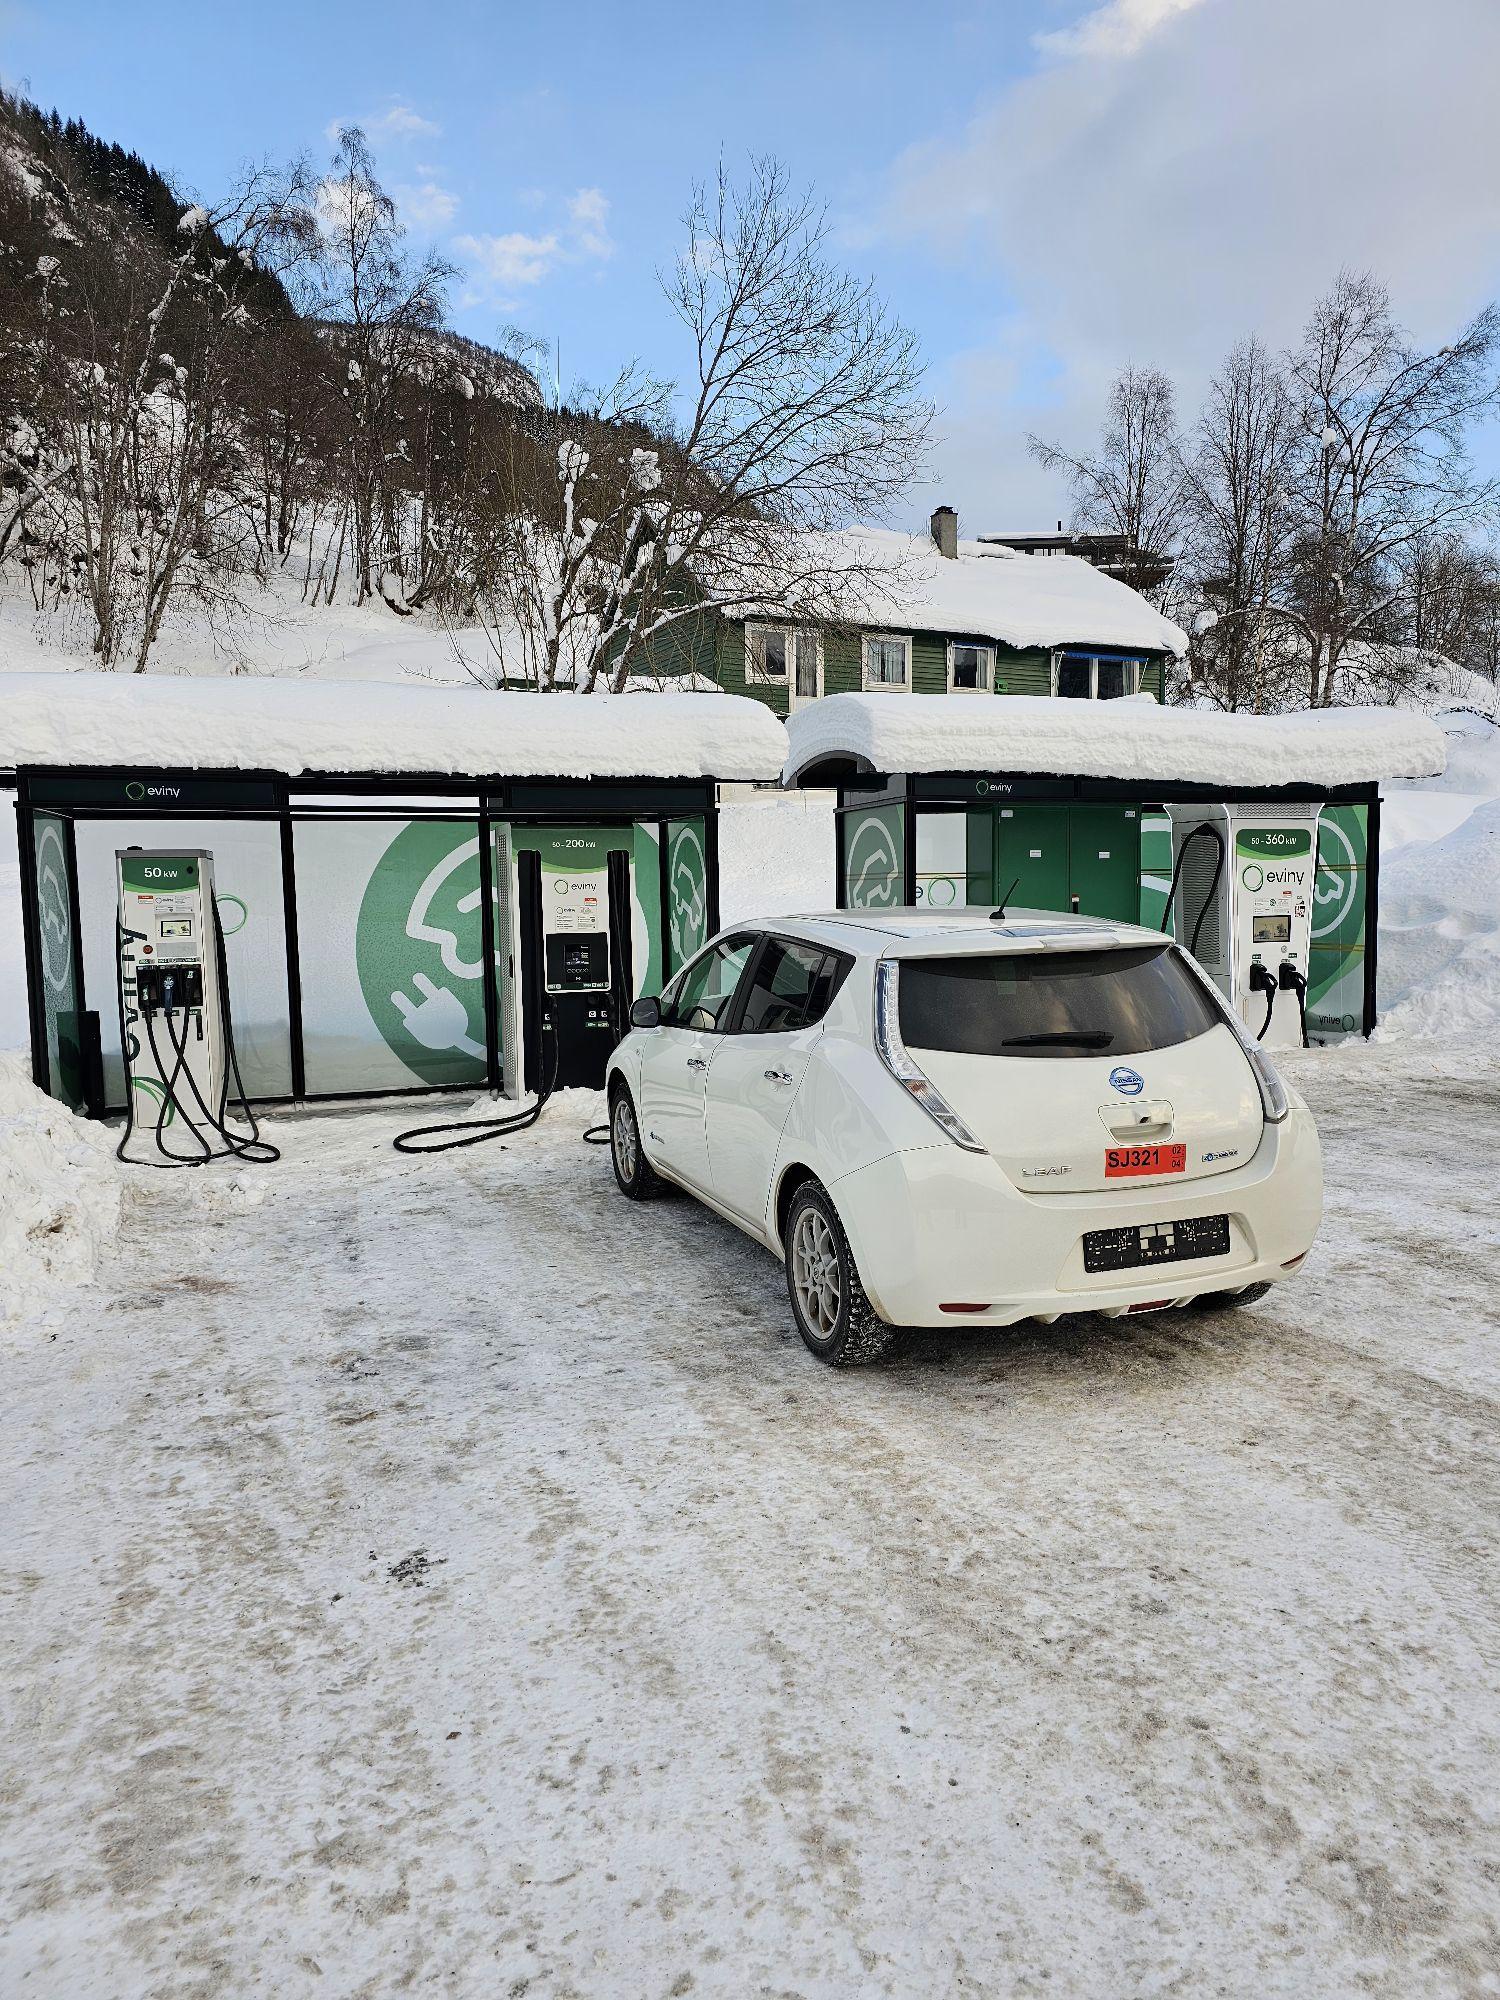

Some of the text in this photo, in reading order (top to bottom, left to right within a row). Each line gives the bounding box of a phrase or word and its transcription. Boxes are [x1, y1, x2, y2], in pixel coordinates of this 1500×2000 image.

[147, 785, 180, 798] eviny
[990, 783, 1012, 793] eviny
[565, 839, 585, 848] 200
[1251, 837, 1260, 845] 50
[1265, 834, 1285, 845] 360
[144, 867, 178, 878] 50 kW
[1266, 868, 1304, 885] eviny
[571, 882, 596, 891] eviny
[1172, 1146, 1182, 1154] 02
[1108, 1149, 1159, 1168] SJ321
[1171, 1160, 1181, 1168] 04
[1021, 1165, 1072, 1177] LEAF
